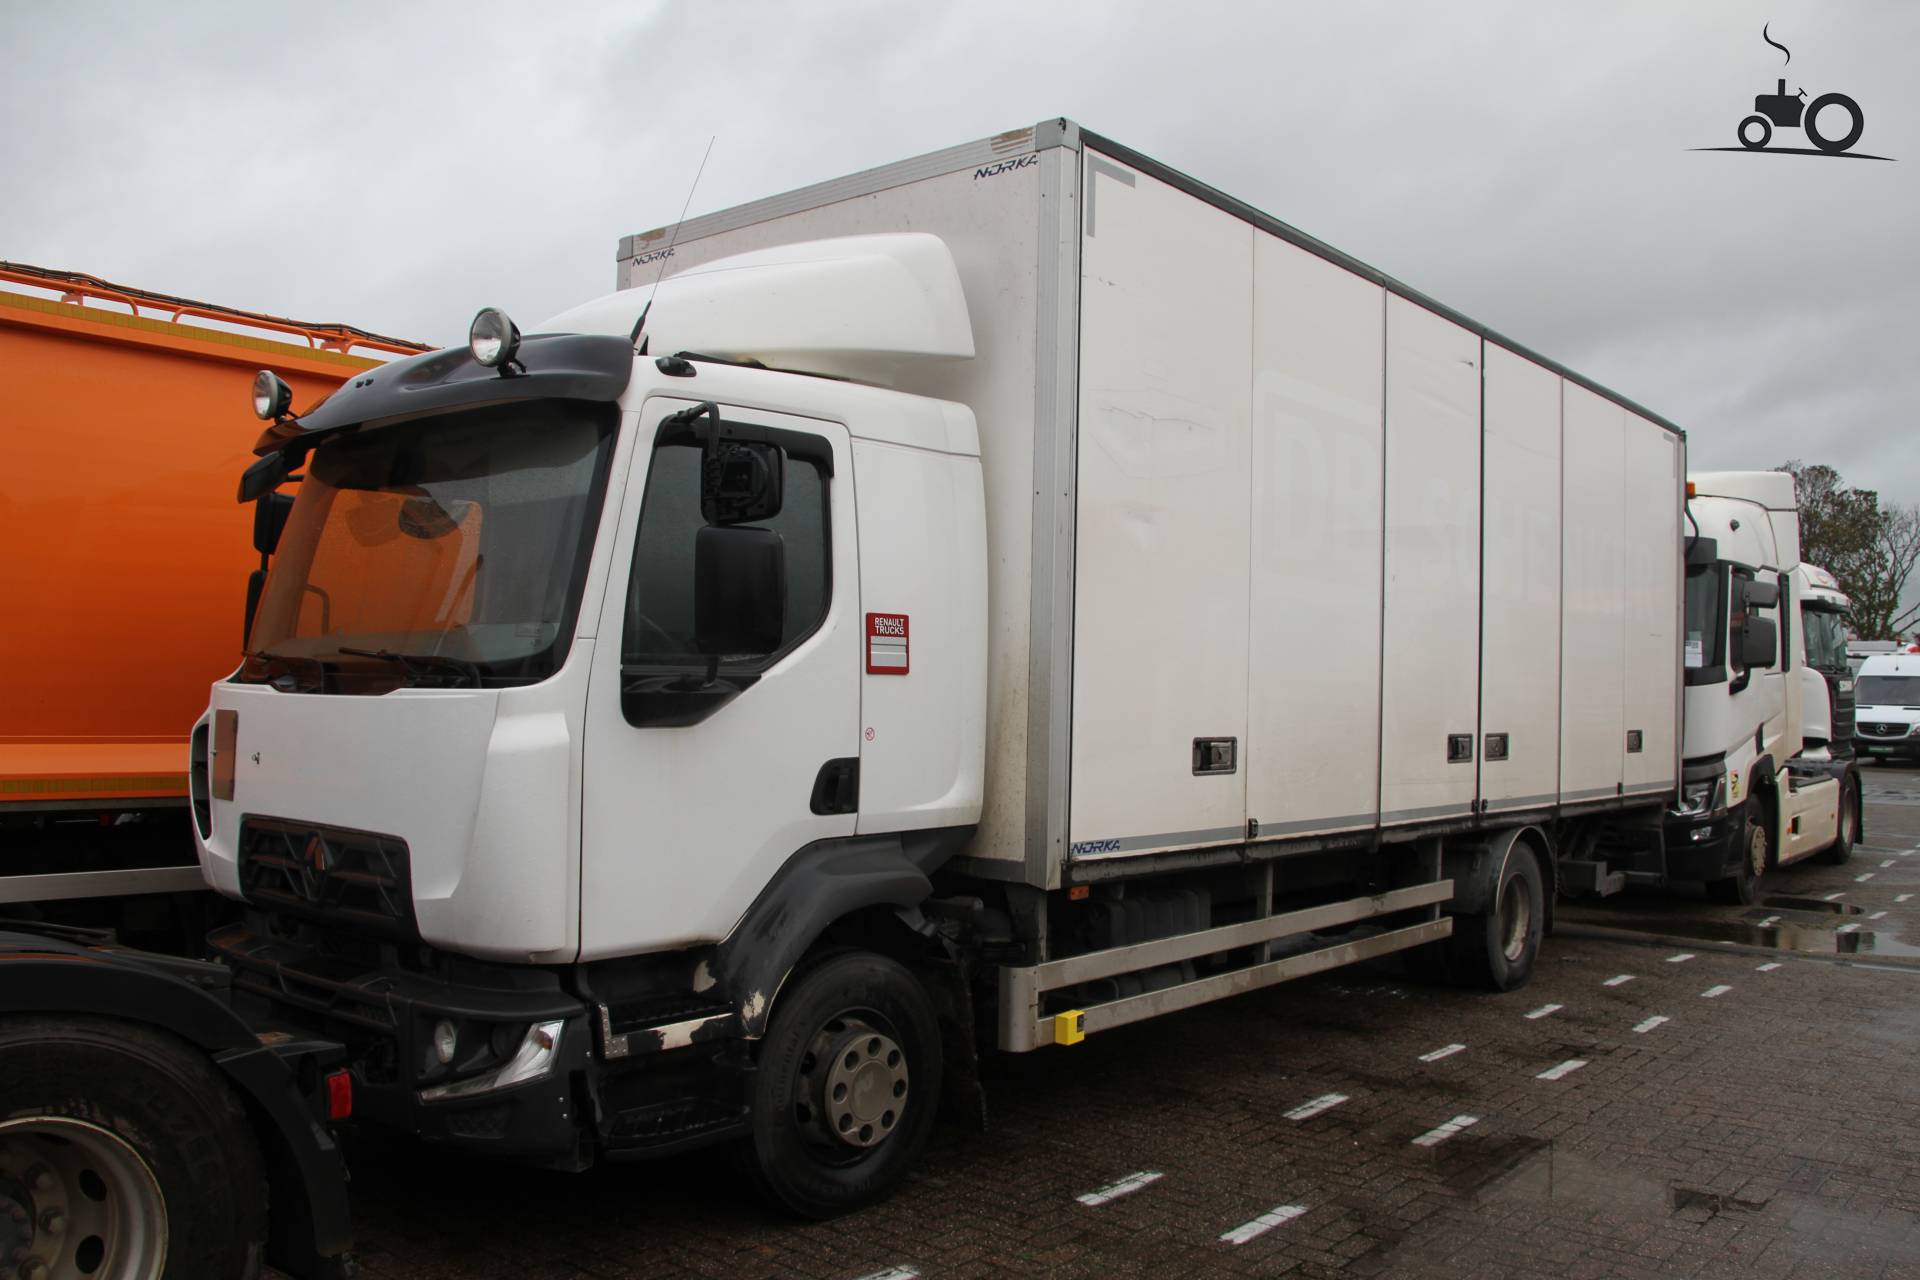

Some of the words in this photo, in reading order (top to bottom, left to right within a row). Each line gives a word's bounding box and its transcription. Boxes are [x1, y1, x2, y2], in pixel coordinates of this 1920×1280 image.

[973, 154, 1039, 180] NORKA
[874, 617, 904, 627] RENAULT
[875, 626, 904, 635] TRUCKS
[1071, 840, 1120, 854] NORKA
